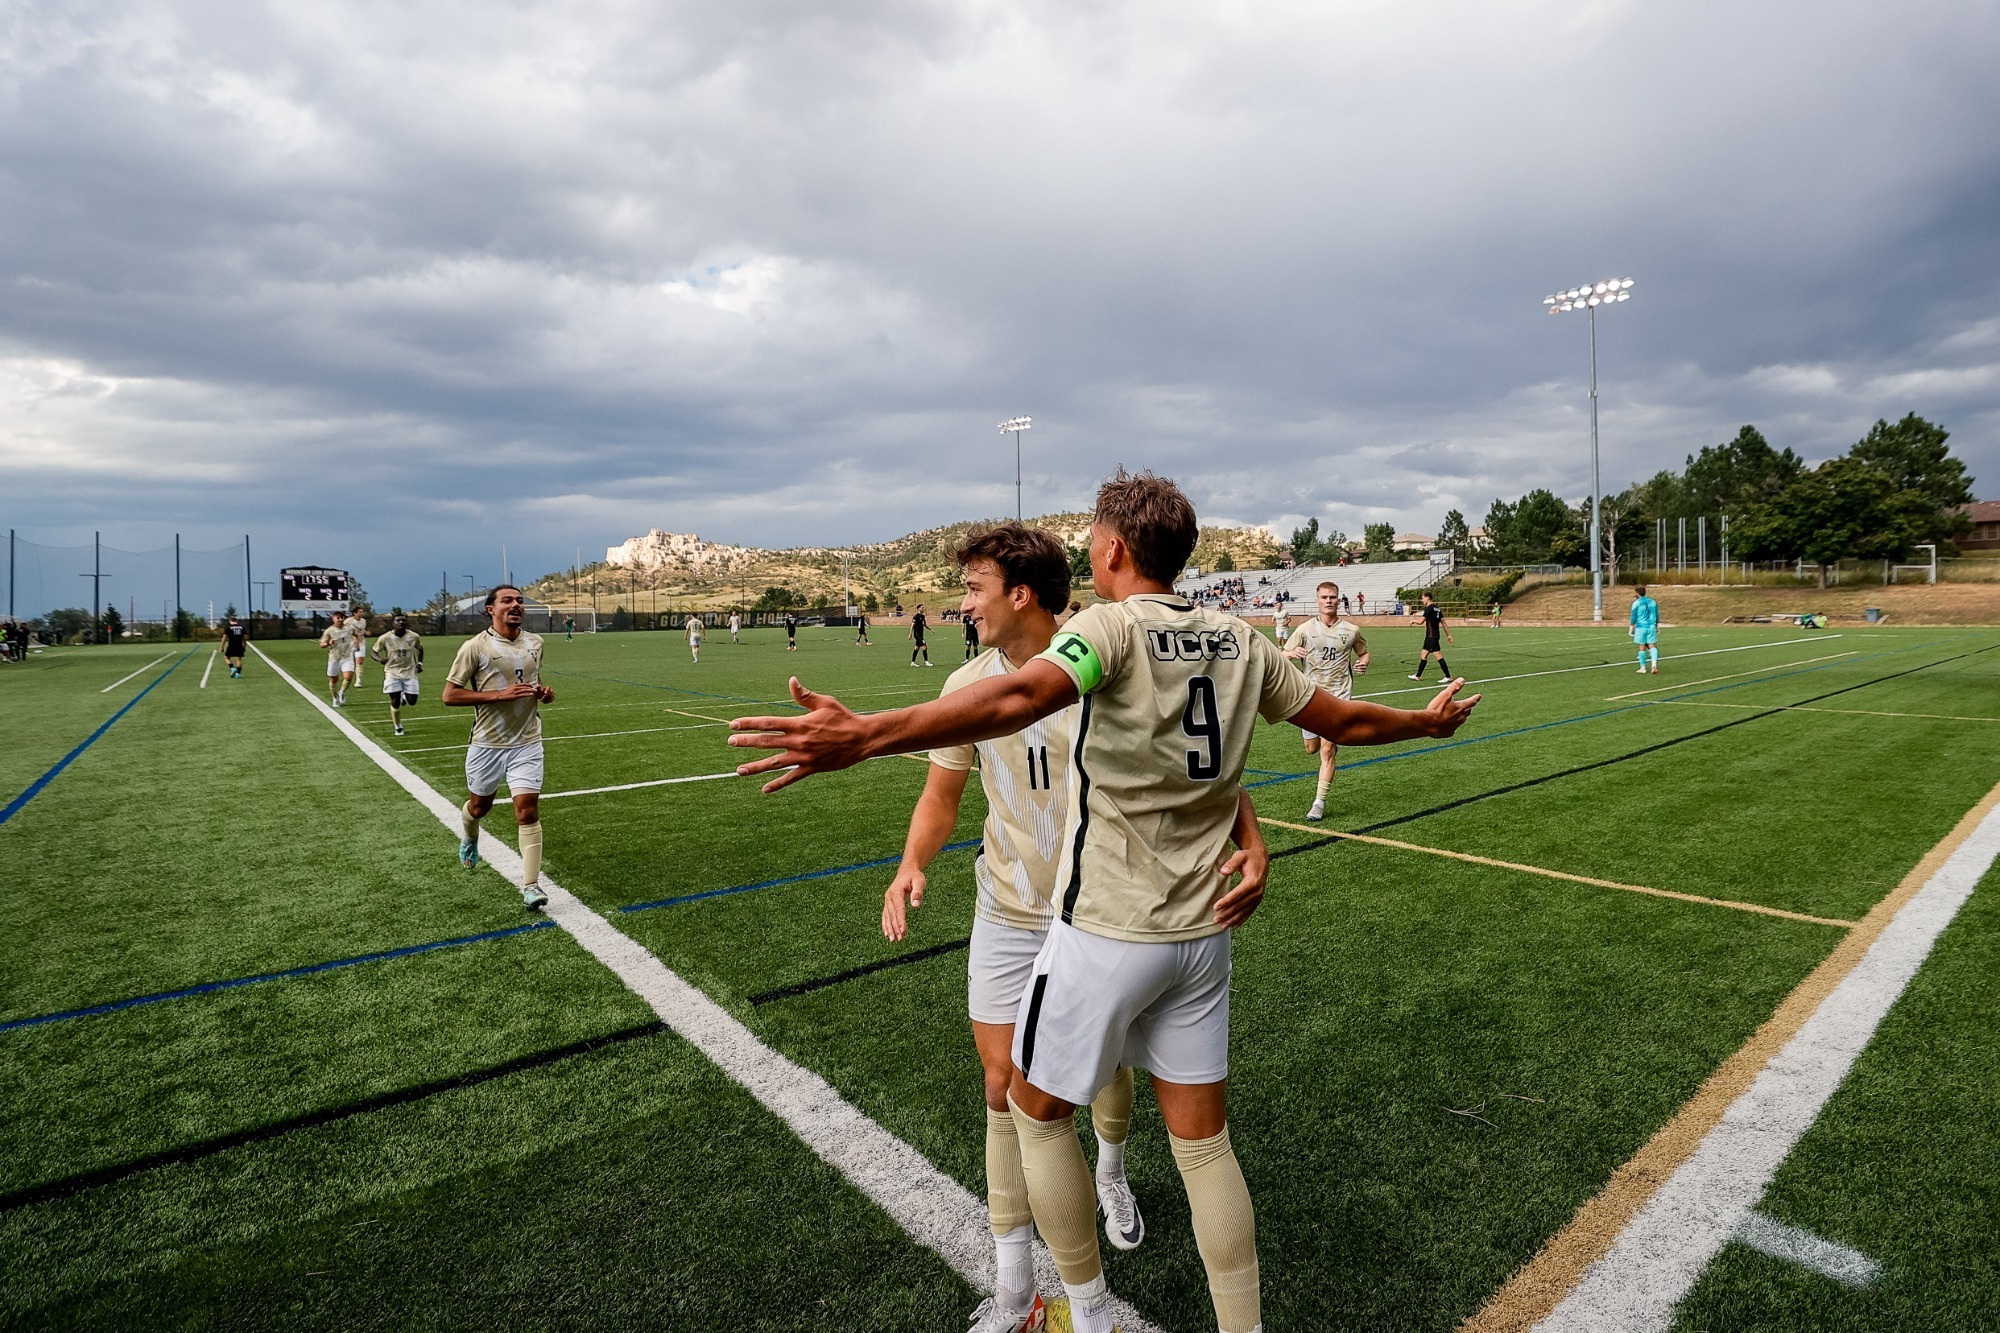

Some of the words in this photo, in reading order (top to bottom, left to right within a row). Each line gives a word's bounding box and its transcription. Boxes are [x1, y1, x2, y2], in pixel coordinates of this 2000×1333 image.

[660, 615, 678, 627] GO
[397, 649, 407, 657] 29
[1056, 637, 1089, 664] C
[1147, 629, 1241, 662] UCCS
[1322, 646, 1336, 660] 26
[515, 668, 524, 685] 3
[1181, 674, 1224, 782] 9
[1027, 745, 1050, 791] 11
